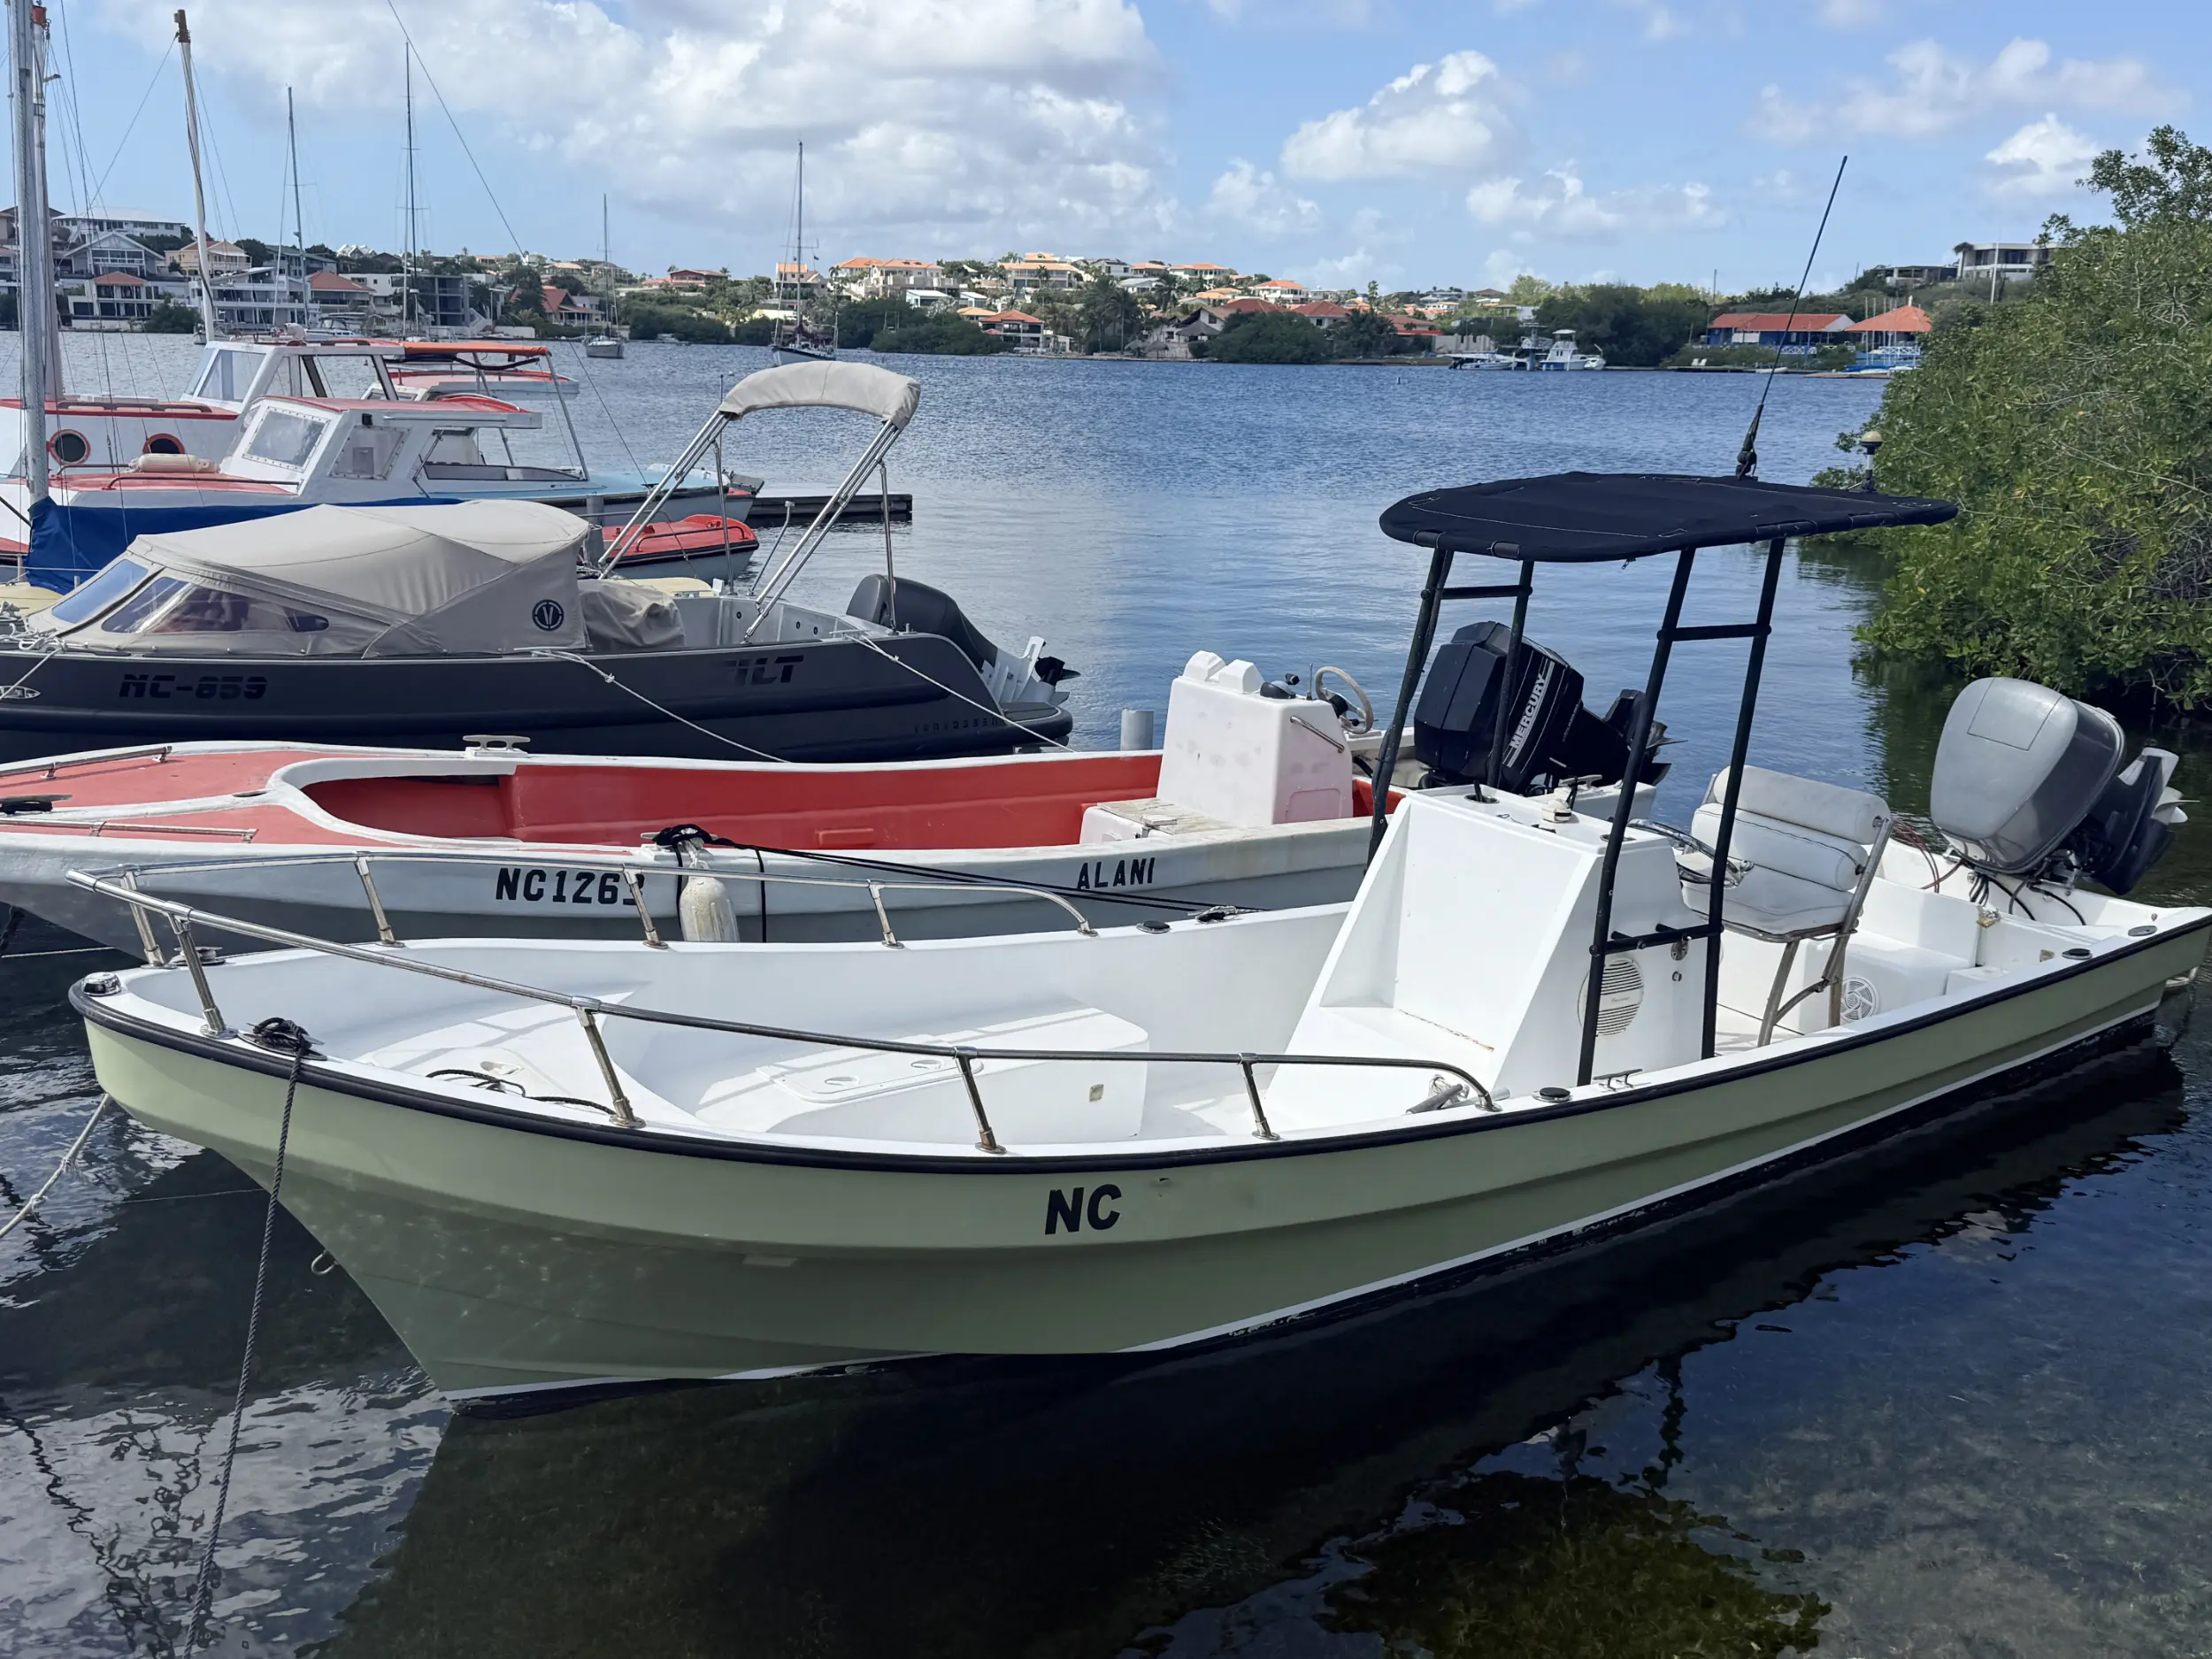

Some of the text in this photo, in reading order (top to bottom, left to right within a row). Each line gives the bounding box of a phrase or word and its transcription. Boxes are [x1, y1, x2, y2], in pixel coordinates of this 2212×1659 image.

[119, 673, 267, 700] NC-859
[1509, 672, 1546, 749] MERCURY
[1077, 857, 1156, 889] ALANI
[1045, 1184, 1122, 1235] NC
